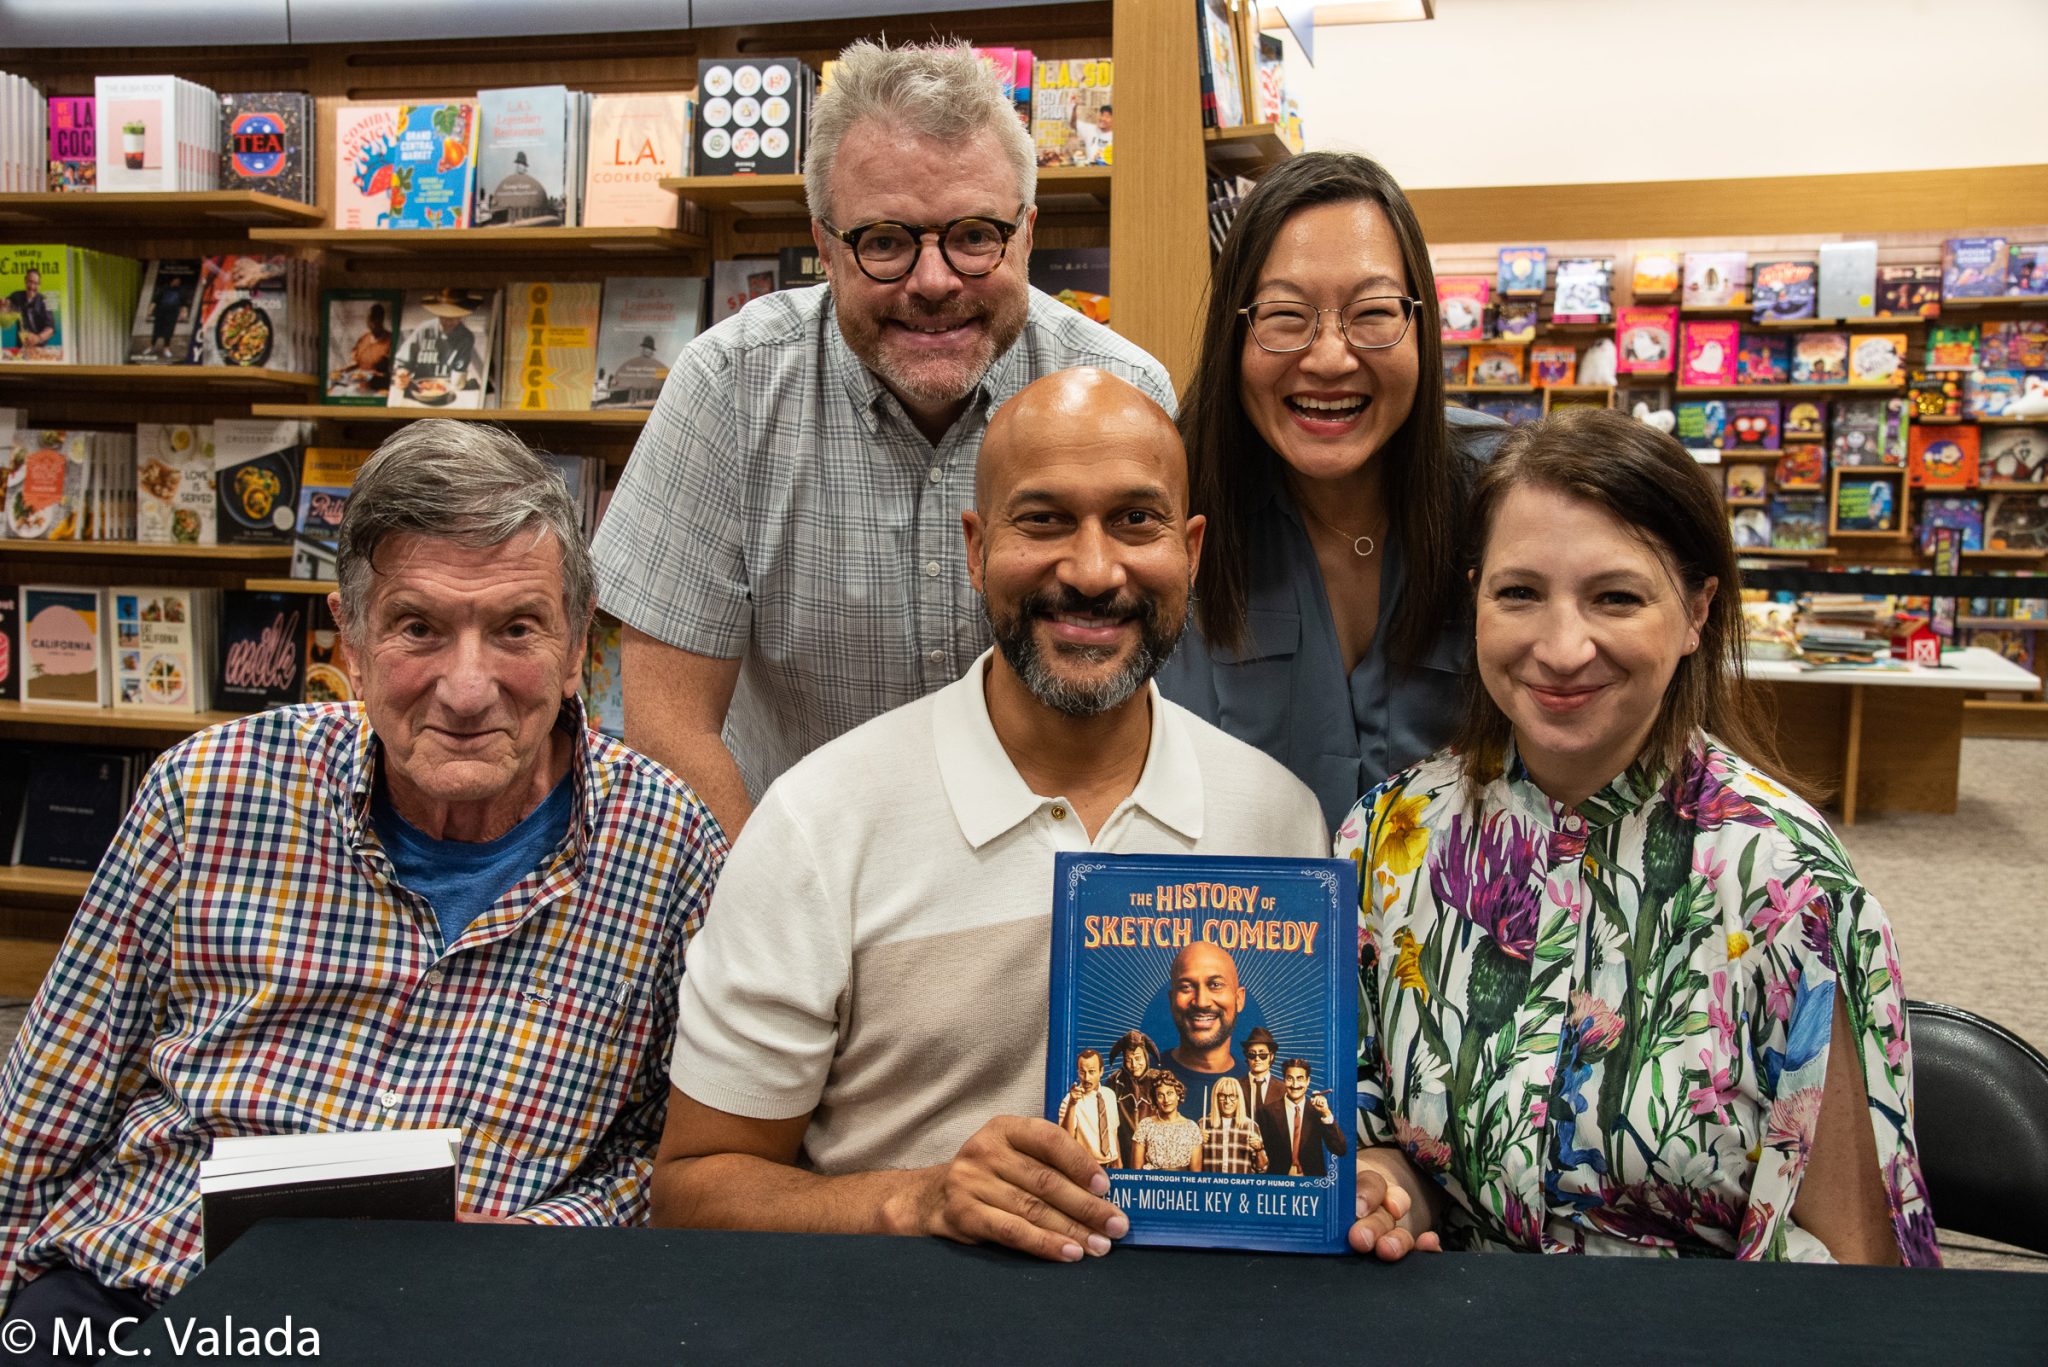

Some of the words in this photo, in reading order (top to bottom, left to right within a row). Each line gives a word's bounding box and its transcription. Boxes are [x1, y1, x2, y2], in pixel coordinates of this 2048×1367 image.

[1039, 63, 1080, 89] L.A.
[73, 103, 93, 128] LA
[234, 135, 284, 153] TEA
[615, 139, 665, 166] L.A.
[184, 471, 208, 480] LOVE
[193, 483, 201, 492] IS
[180, 495, 213, 505] SERVED
[31, 639, 92, 651] CALIFORNIA
[1129, 893, 1153, 907] THE
[1156, 882, 1260, 913] HISTORY
[1260, 897, 1276, 911] OF
[1084, 915, 1195, 949] SKETCH
[1201, 918, 1320, 955] COMEDY
[1109, 1173, 1143, 1181] JOURNEY
[1145, 1174, 1181, 1183] THROUGH
[1182, 1176, 1197, 1184] THE
[1213, 1177, 1229, 1185] AND
[1230, 1178, 1255, 1186] CRAFT
[1256, 1179, 1267, 1187] OF
[1268, 1180, 1296, 1188] HUMOR
[1205, 1191, 1233, 1214] KEY
[1239, 1195, 1250, 1214] &
[1257, 1193, 1288, 1216] ELLE
[1292, 1195, 1320, 1217] KEY
